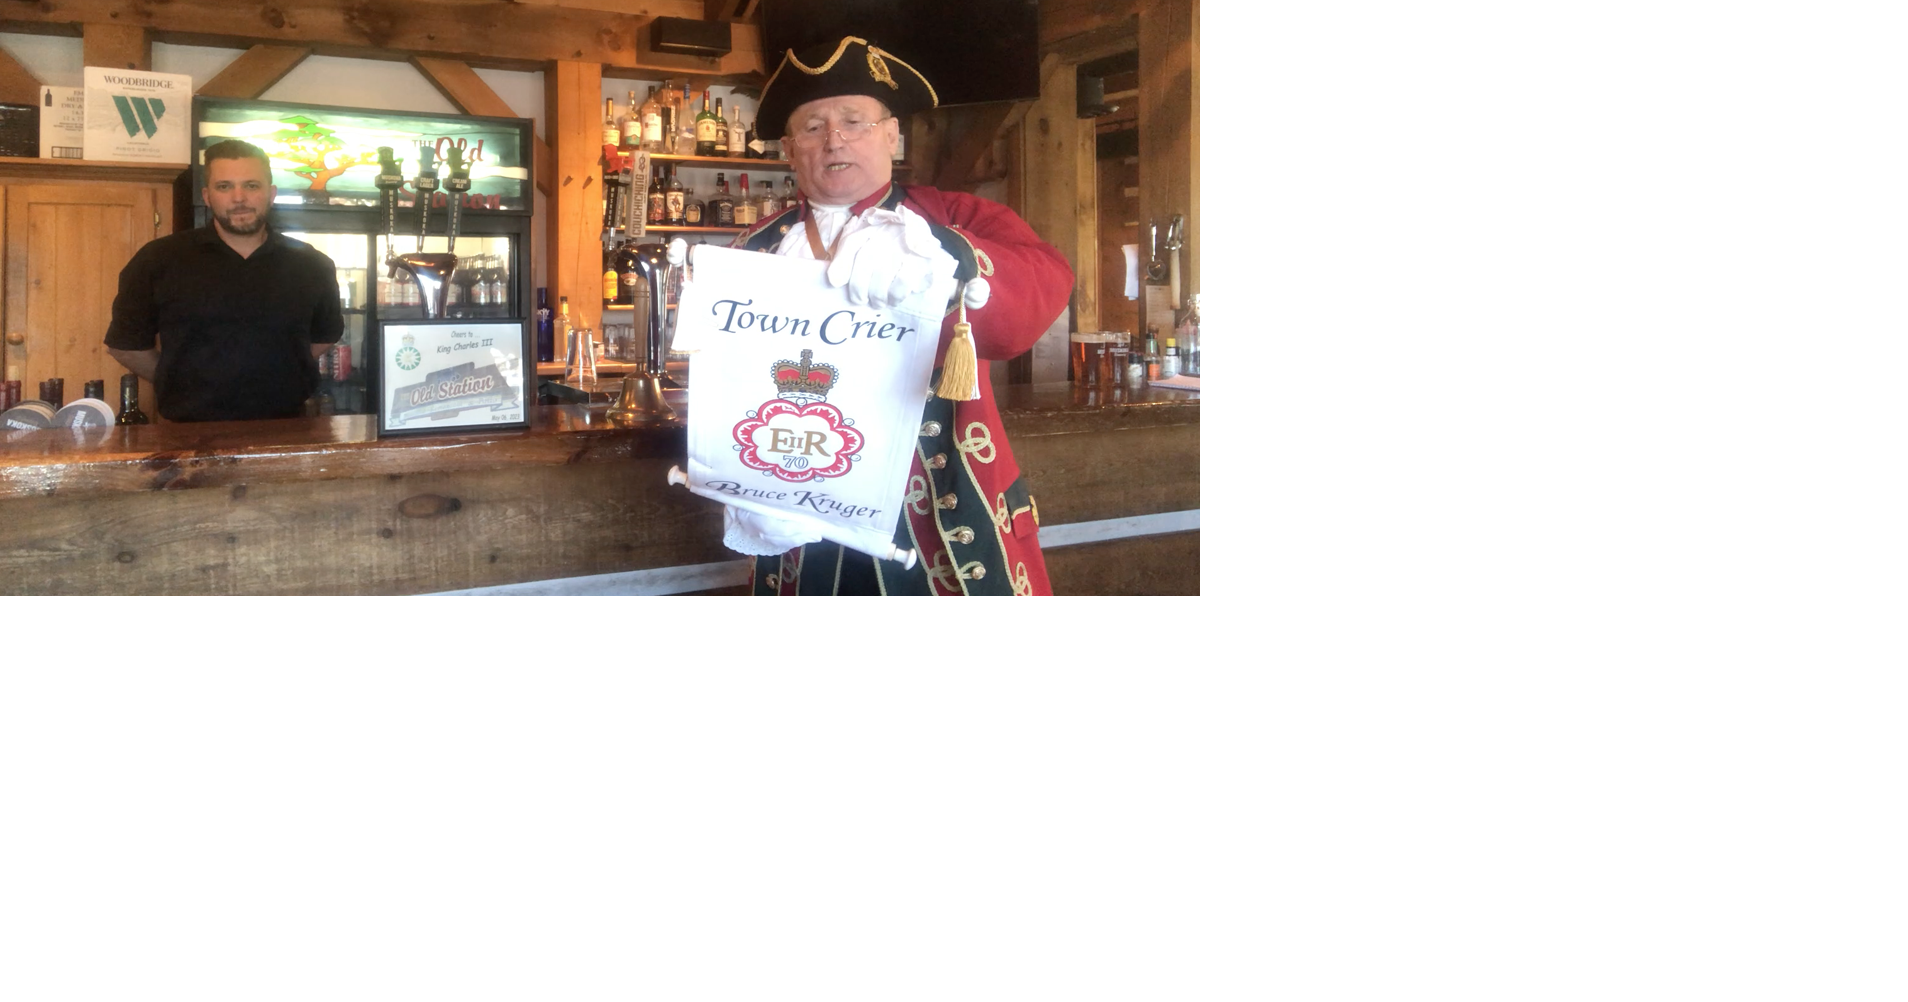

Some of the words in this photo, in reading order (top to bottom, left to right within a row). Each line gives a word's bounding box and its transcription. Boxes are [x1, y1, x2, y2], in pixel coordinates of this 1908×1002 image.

[103, 75, 173, 89] WOODBRIDGE
[398, 181, 501, 209] Saion
[632, 174, 645, 235] COUCHICHING
[451, 330, 467, 338] Cheers
[712, 299, 811, 337] Town
[819, 310, 915, 346] Crier
[437, 345, 451, 355] King
[454, 341, 479, 351] Charles
[481, 338, 493, 347] III
[410, 384, 435, 407] Old
[438, 375, 495, 399] Station
[783, 455, 809, 469] 70
[705, 480, 787, 500] Bruce
[793, 490, 882, 518] Kruger
